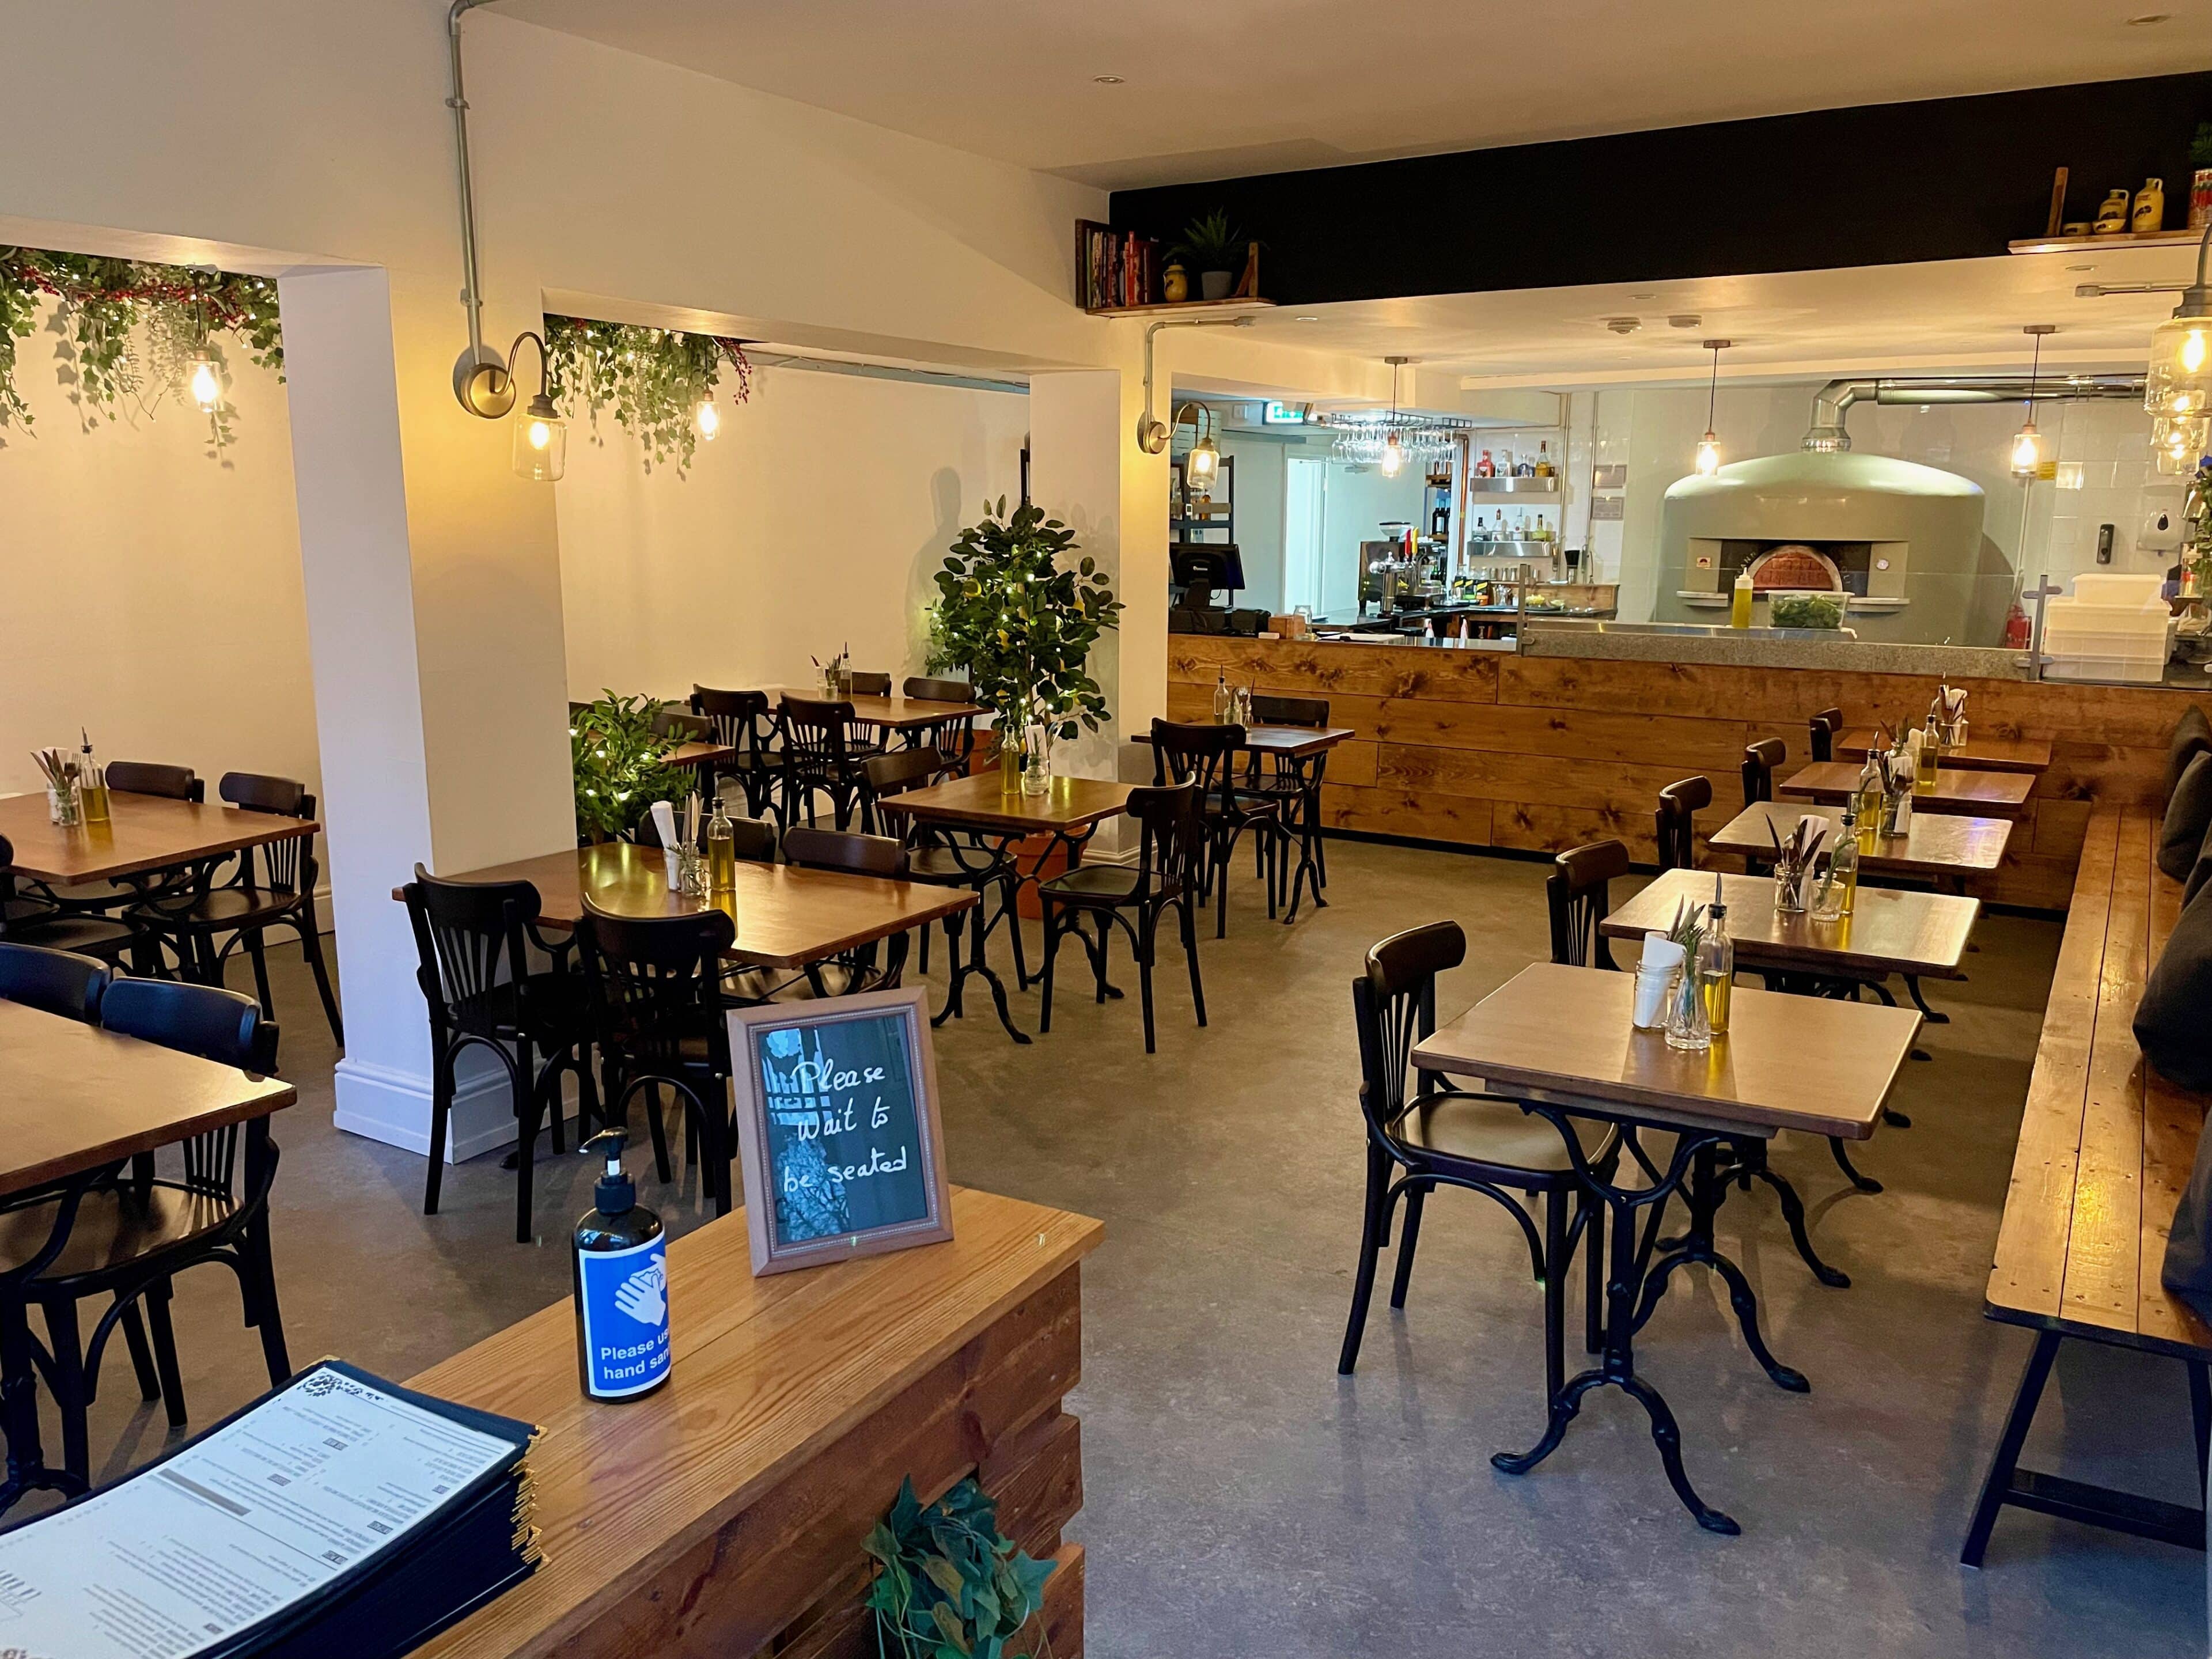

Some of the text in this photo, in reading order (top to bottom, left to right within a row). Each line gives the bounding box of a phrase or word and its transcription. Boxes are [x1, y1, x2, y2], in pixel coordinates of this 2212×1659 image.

[790, 1058, 885, 1092] Please
[871, 1096, 890, 1128] to
[783, 1146, 907, 1192] be seated
[601, 1328, 669, 1360] Please us
[604, 1347, 669, 1380] hand san
